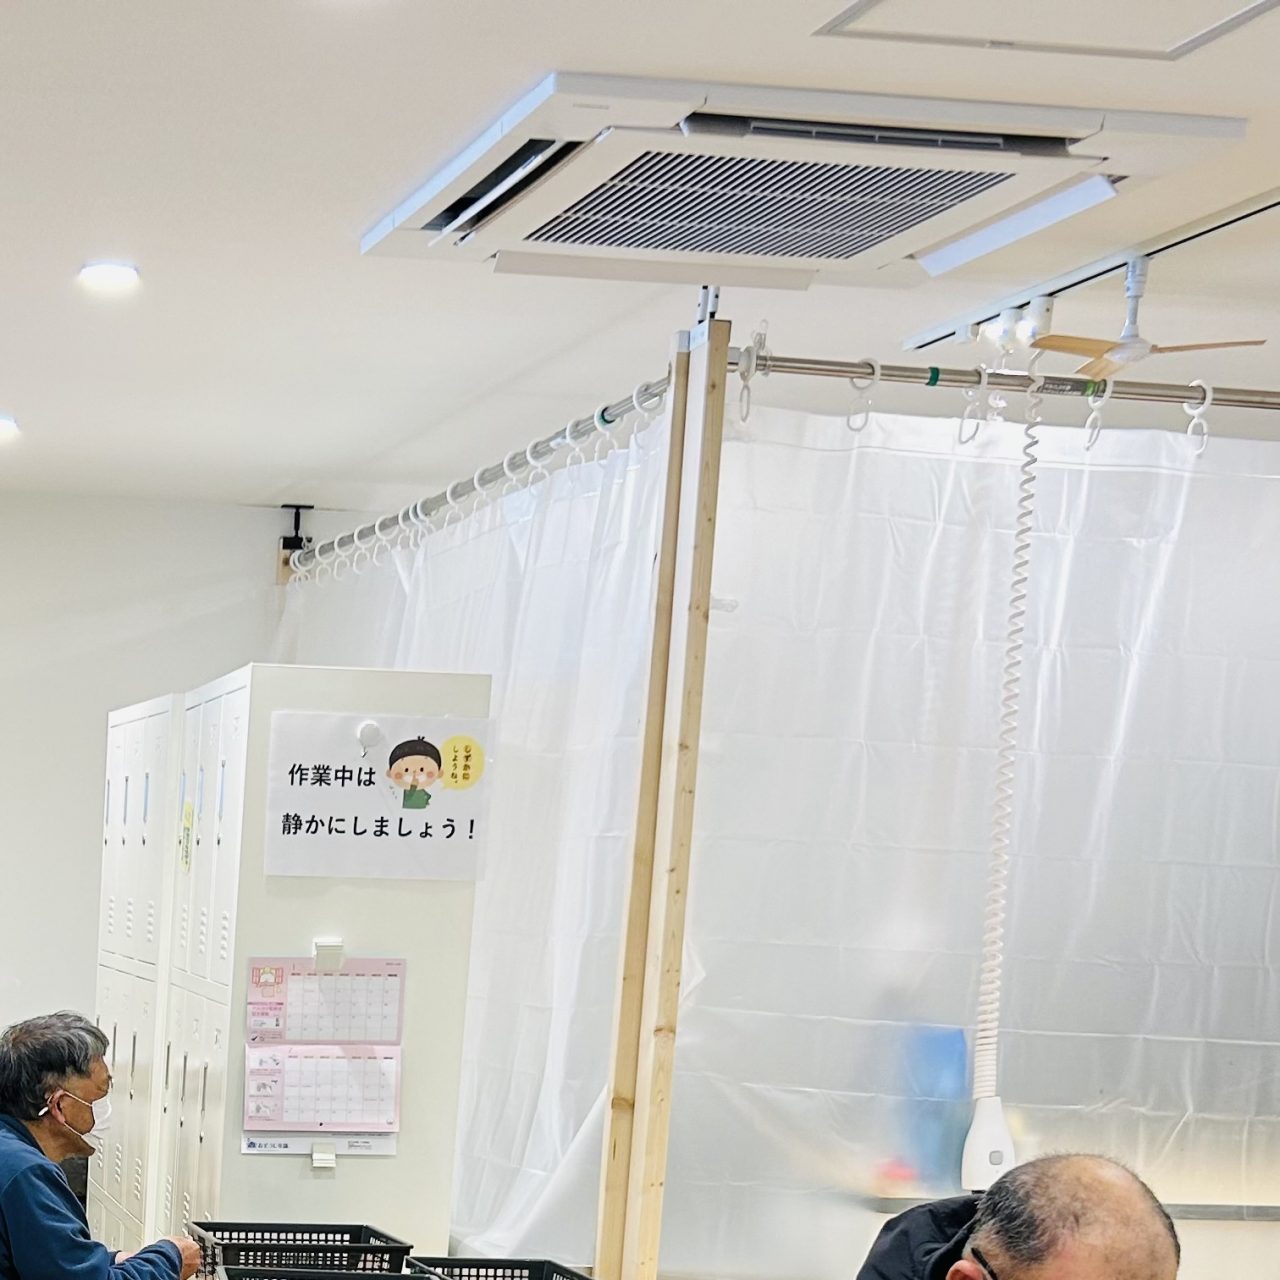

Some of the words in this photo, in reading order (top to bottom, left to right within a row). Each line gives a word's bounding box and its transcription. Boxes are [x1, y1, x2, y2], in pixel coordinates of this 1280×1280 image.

[287, 763, 376, 788] 作業中は
[462, 745, 472, 781] しずかに
[281, 812, 476, 840] 静かにしましょう！
